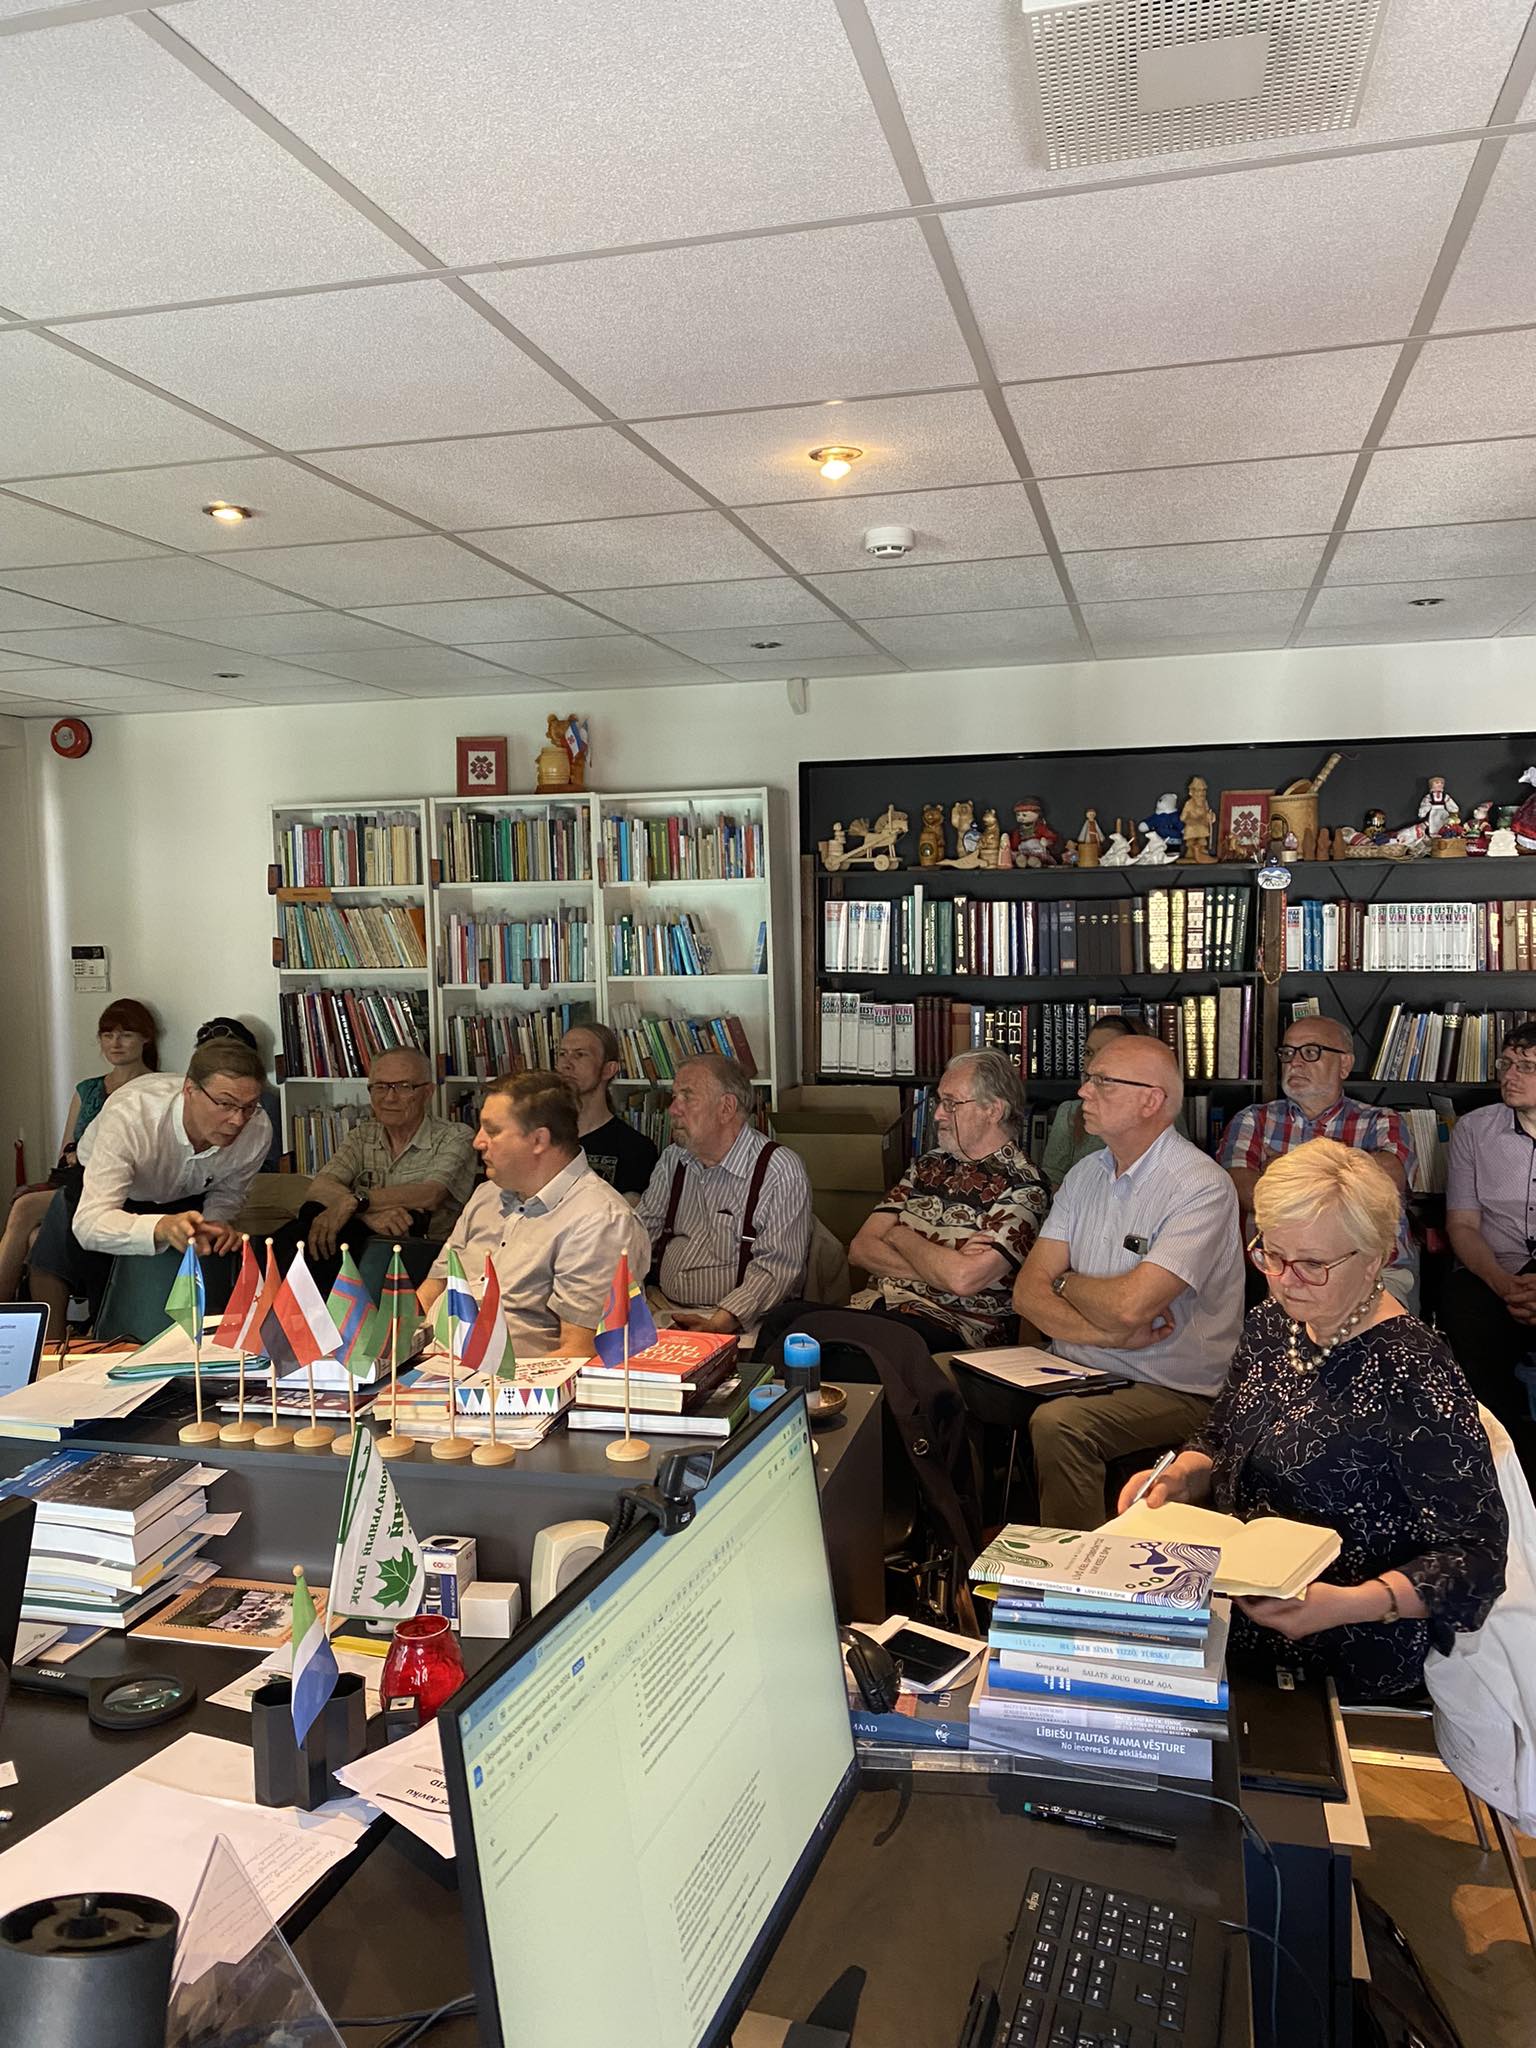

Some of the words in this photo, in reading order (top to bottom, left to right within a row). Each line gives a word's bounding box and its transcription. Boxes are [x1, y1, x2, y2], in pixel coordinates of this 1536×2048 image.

[1133, 1676, 1154, 1686] KOLM
[1036, 1726, 1073, 1740] LĪBIEŠU
[1074, 1731, 1110, 1745] TAUTAS
[1112, 1736, 1141, 1748] NAMA
[1142, 1738, 1186, 1754] VĒSTURE
[1061, 1741, 1072, 1751] No
[1074, 1743, 1101, 1753] ieceres
[1119, 1748, 1160, 1761] atklāšanai
[406, 1788, 440, 1804] Aaviku
